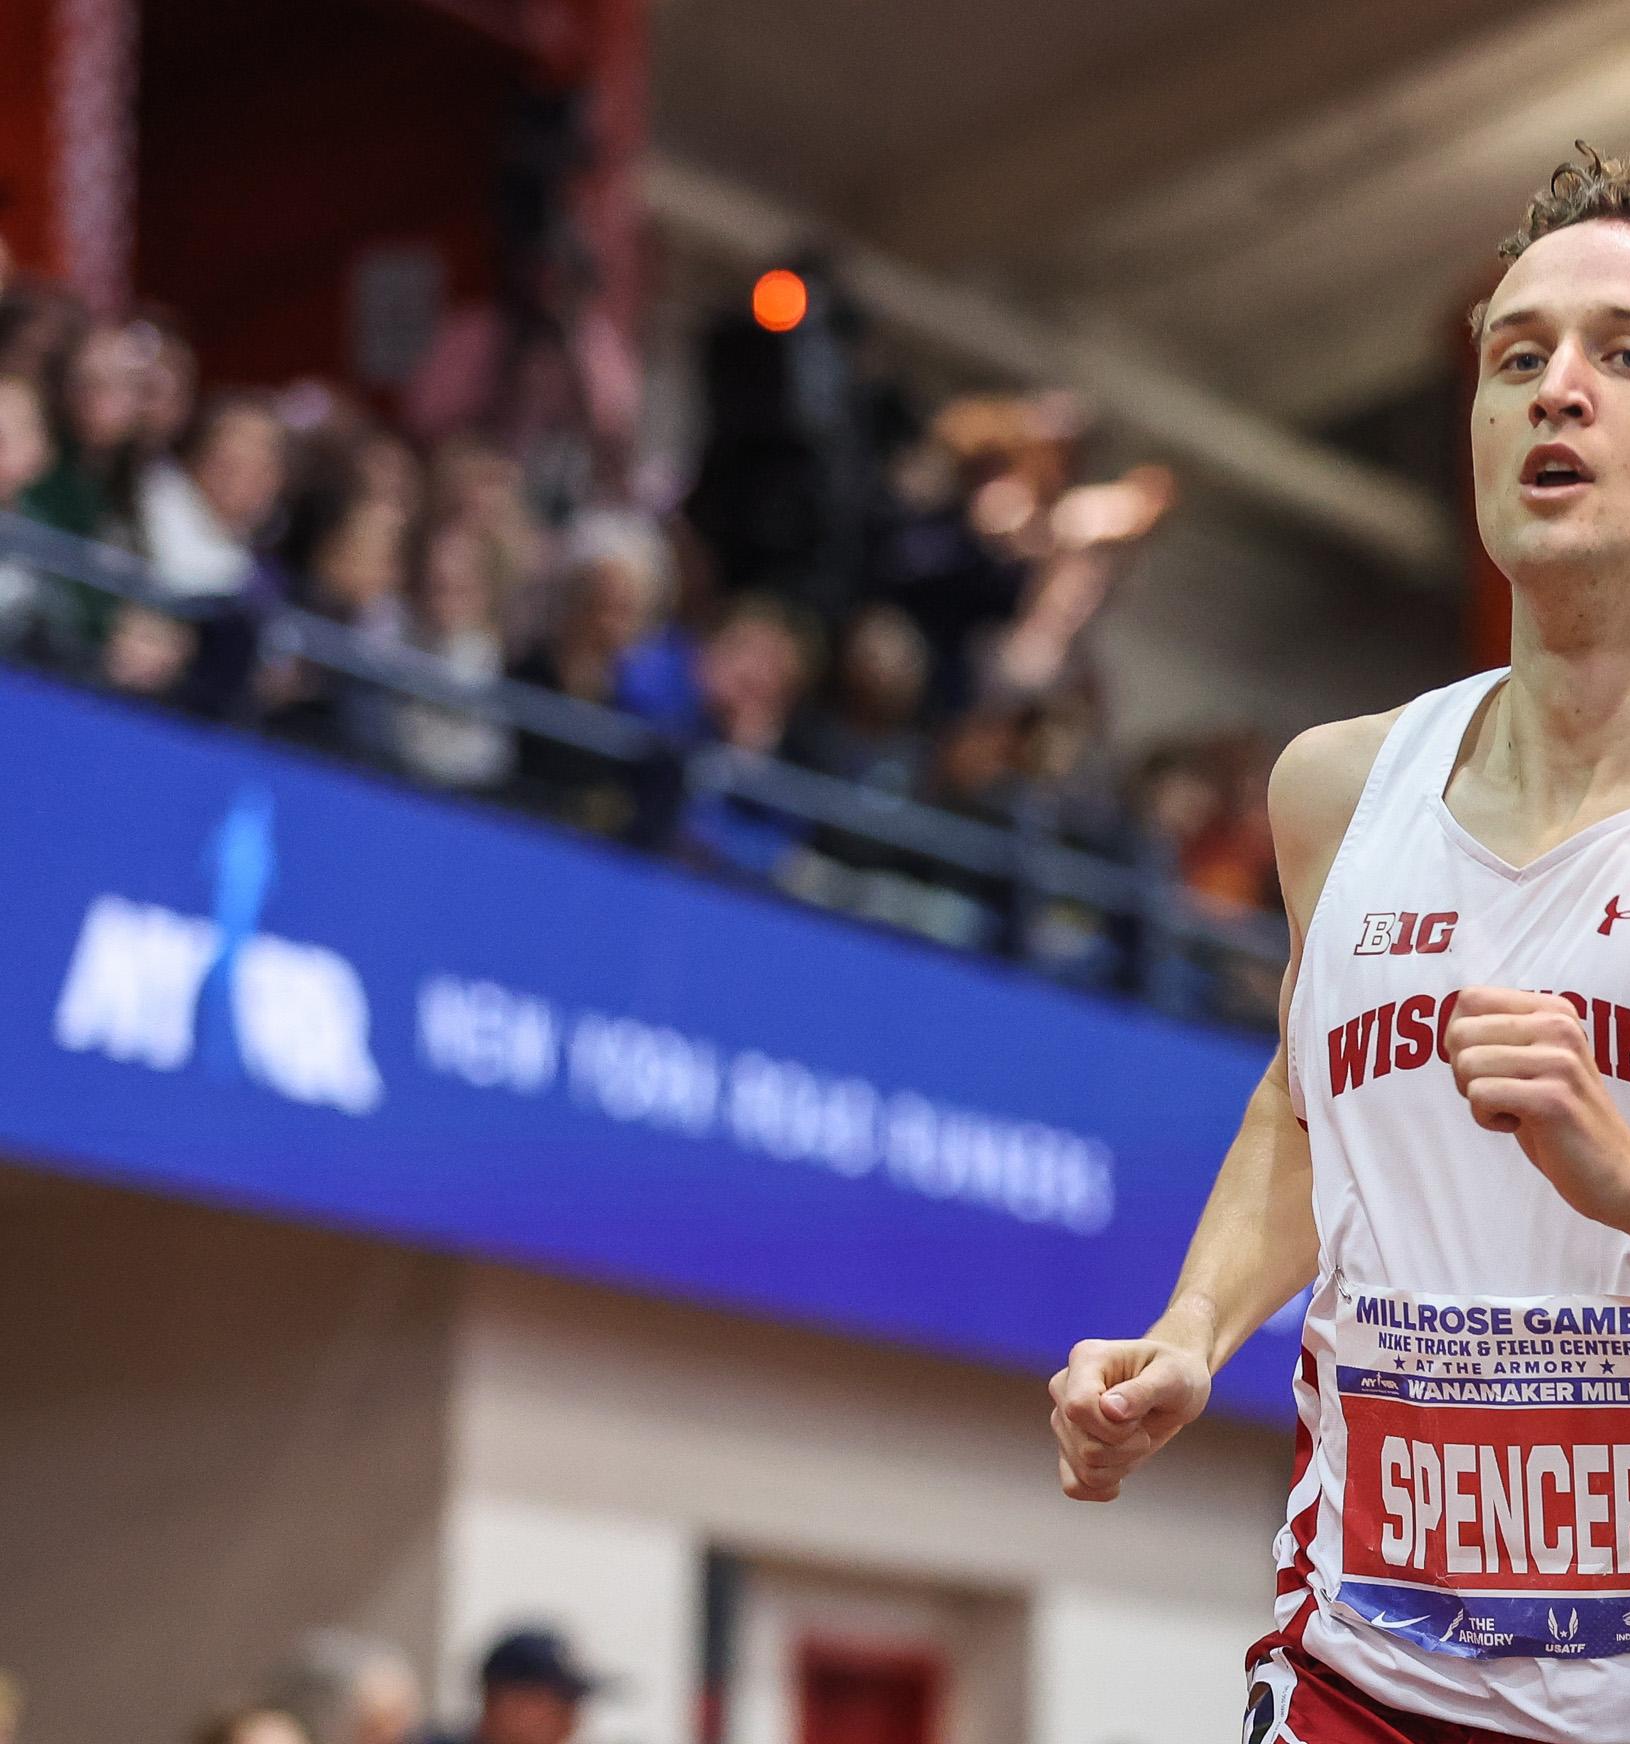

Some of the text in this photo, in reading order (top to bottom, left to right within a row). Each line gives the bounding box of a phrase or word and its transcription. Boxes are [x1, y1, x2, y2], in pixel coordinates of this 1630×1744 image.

[1356, 1296, 1513, 1335] MILLROSE
[1378, 1332, 1412, 1352] NIKE
[1415, 1337, 1471, 1356] TRACK
[1477, 1340, 1491, 1356] &
[1496, 1339, 1554, 1355] FIELD
[1416, 1359, 1587, 1375] AT THE ARMORY
[1408, 1379, 1574, 1402] WANAMAKER
[1469, 1617, 1495, 1631] THE
[1459, 1630, 1513, 1646] ARMORY
[1545, 1643, 1586, 1653] USATF
